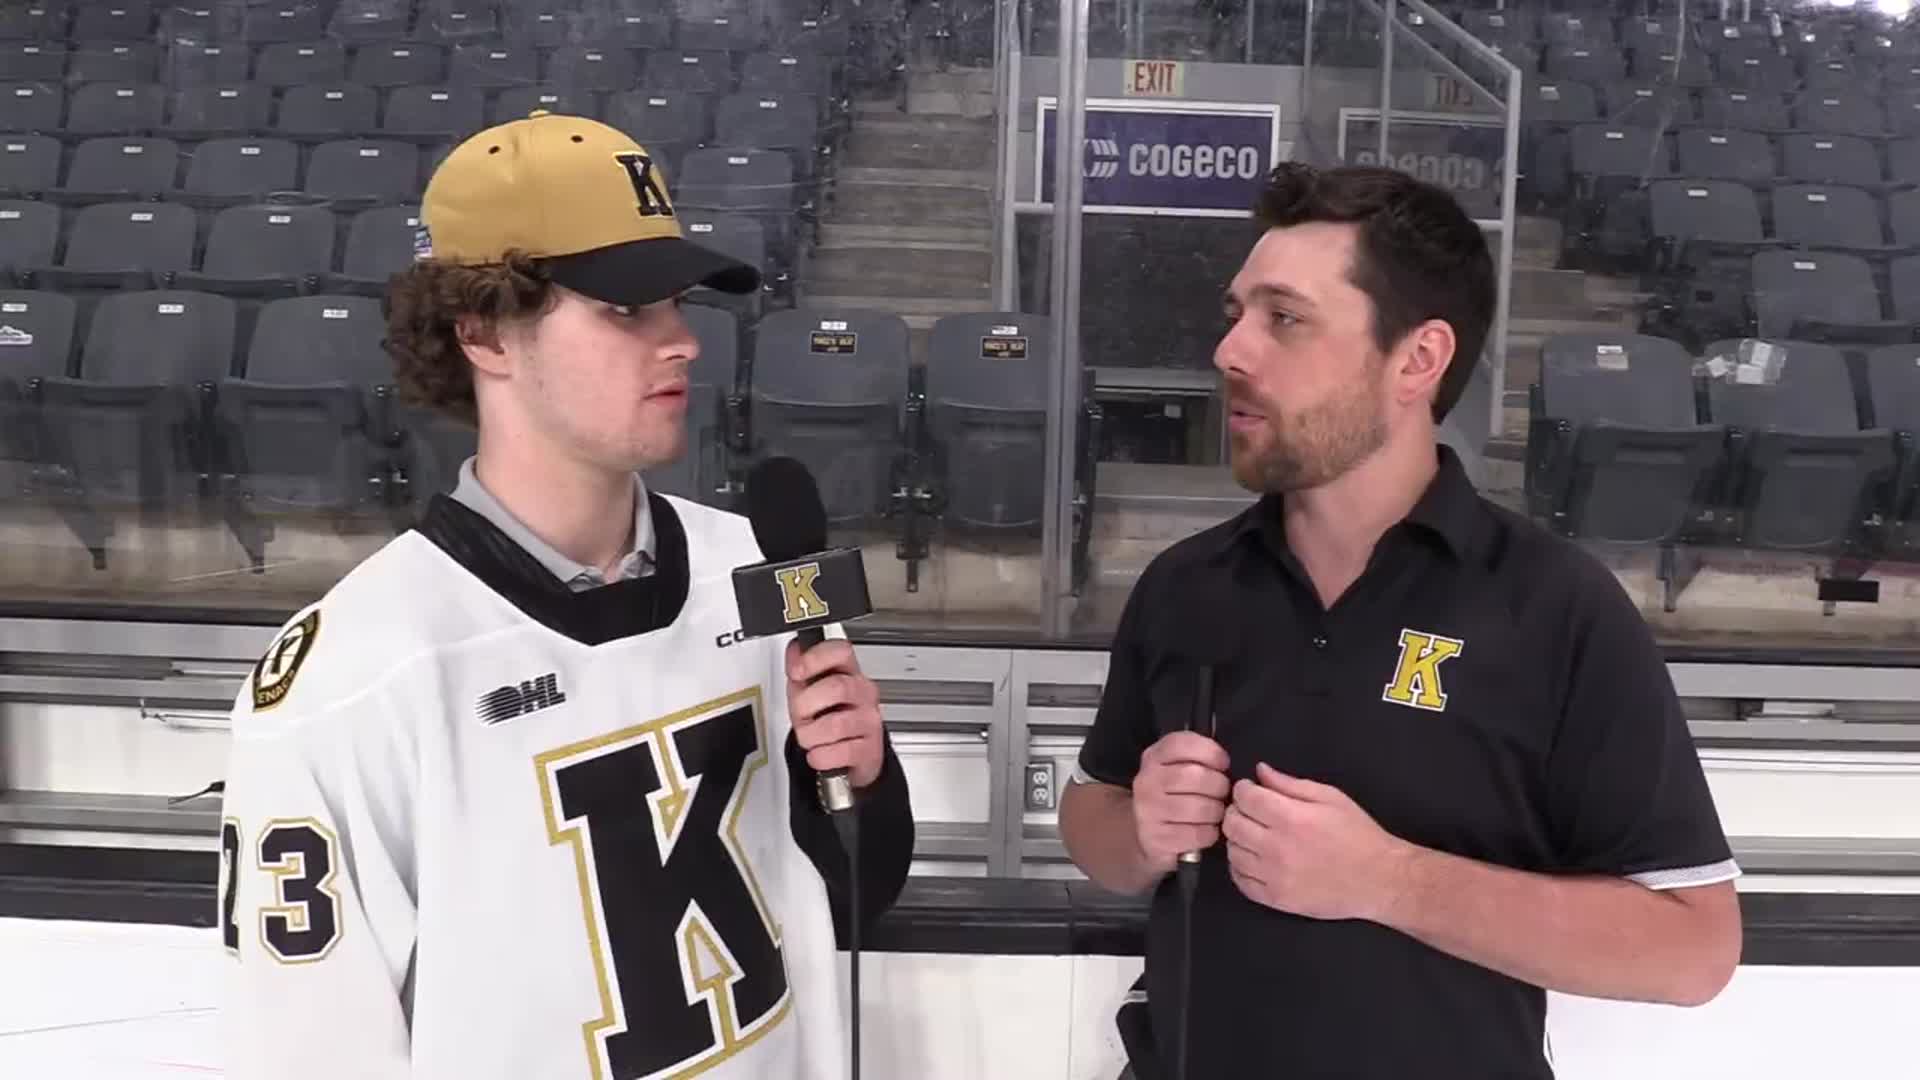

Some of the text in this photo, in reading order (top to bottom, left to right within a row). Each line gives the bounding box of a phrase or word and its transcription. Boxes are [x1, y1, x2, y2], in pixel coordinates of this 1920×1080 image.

[1134, 61, 1176, 93] EXIT
[612, 151, 674, 218] K
[775, 562, 829, 623] K
[476, 672, 566, 725] OHL
[1382, 628, 1464, 712] K
[533, 685, 791, 1080] K
